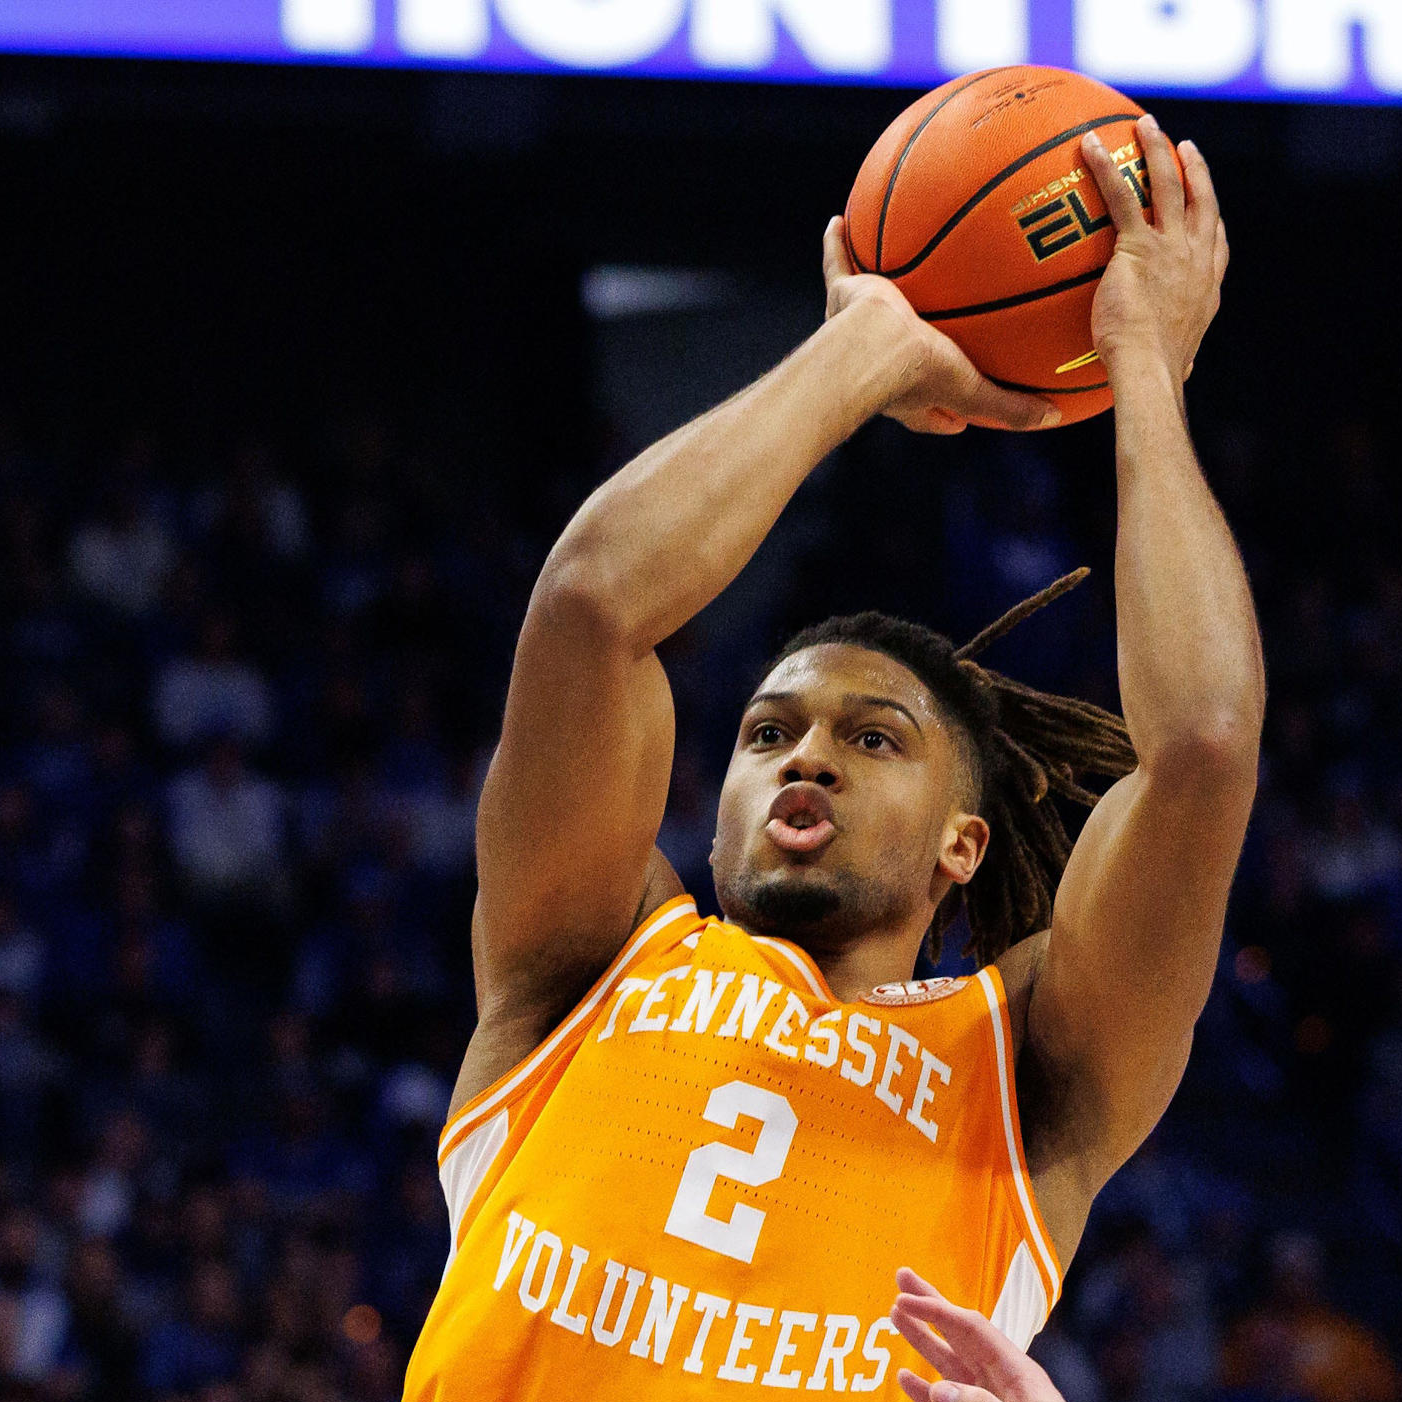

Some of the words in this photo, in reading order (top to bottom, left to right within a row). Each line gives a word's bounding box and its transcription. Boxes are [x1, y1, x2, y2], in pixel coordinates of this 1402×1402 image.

[596, 965, 952, 1144] TENNESSEE
[664, 1080, 798, 1264] 2
[492, 1210, 900, 1393] VOLUNTEERS
